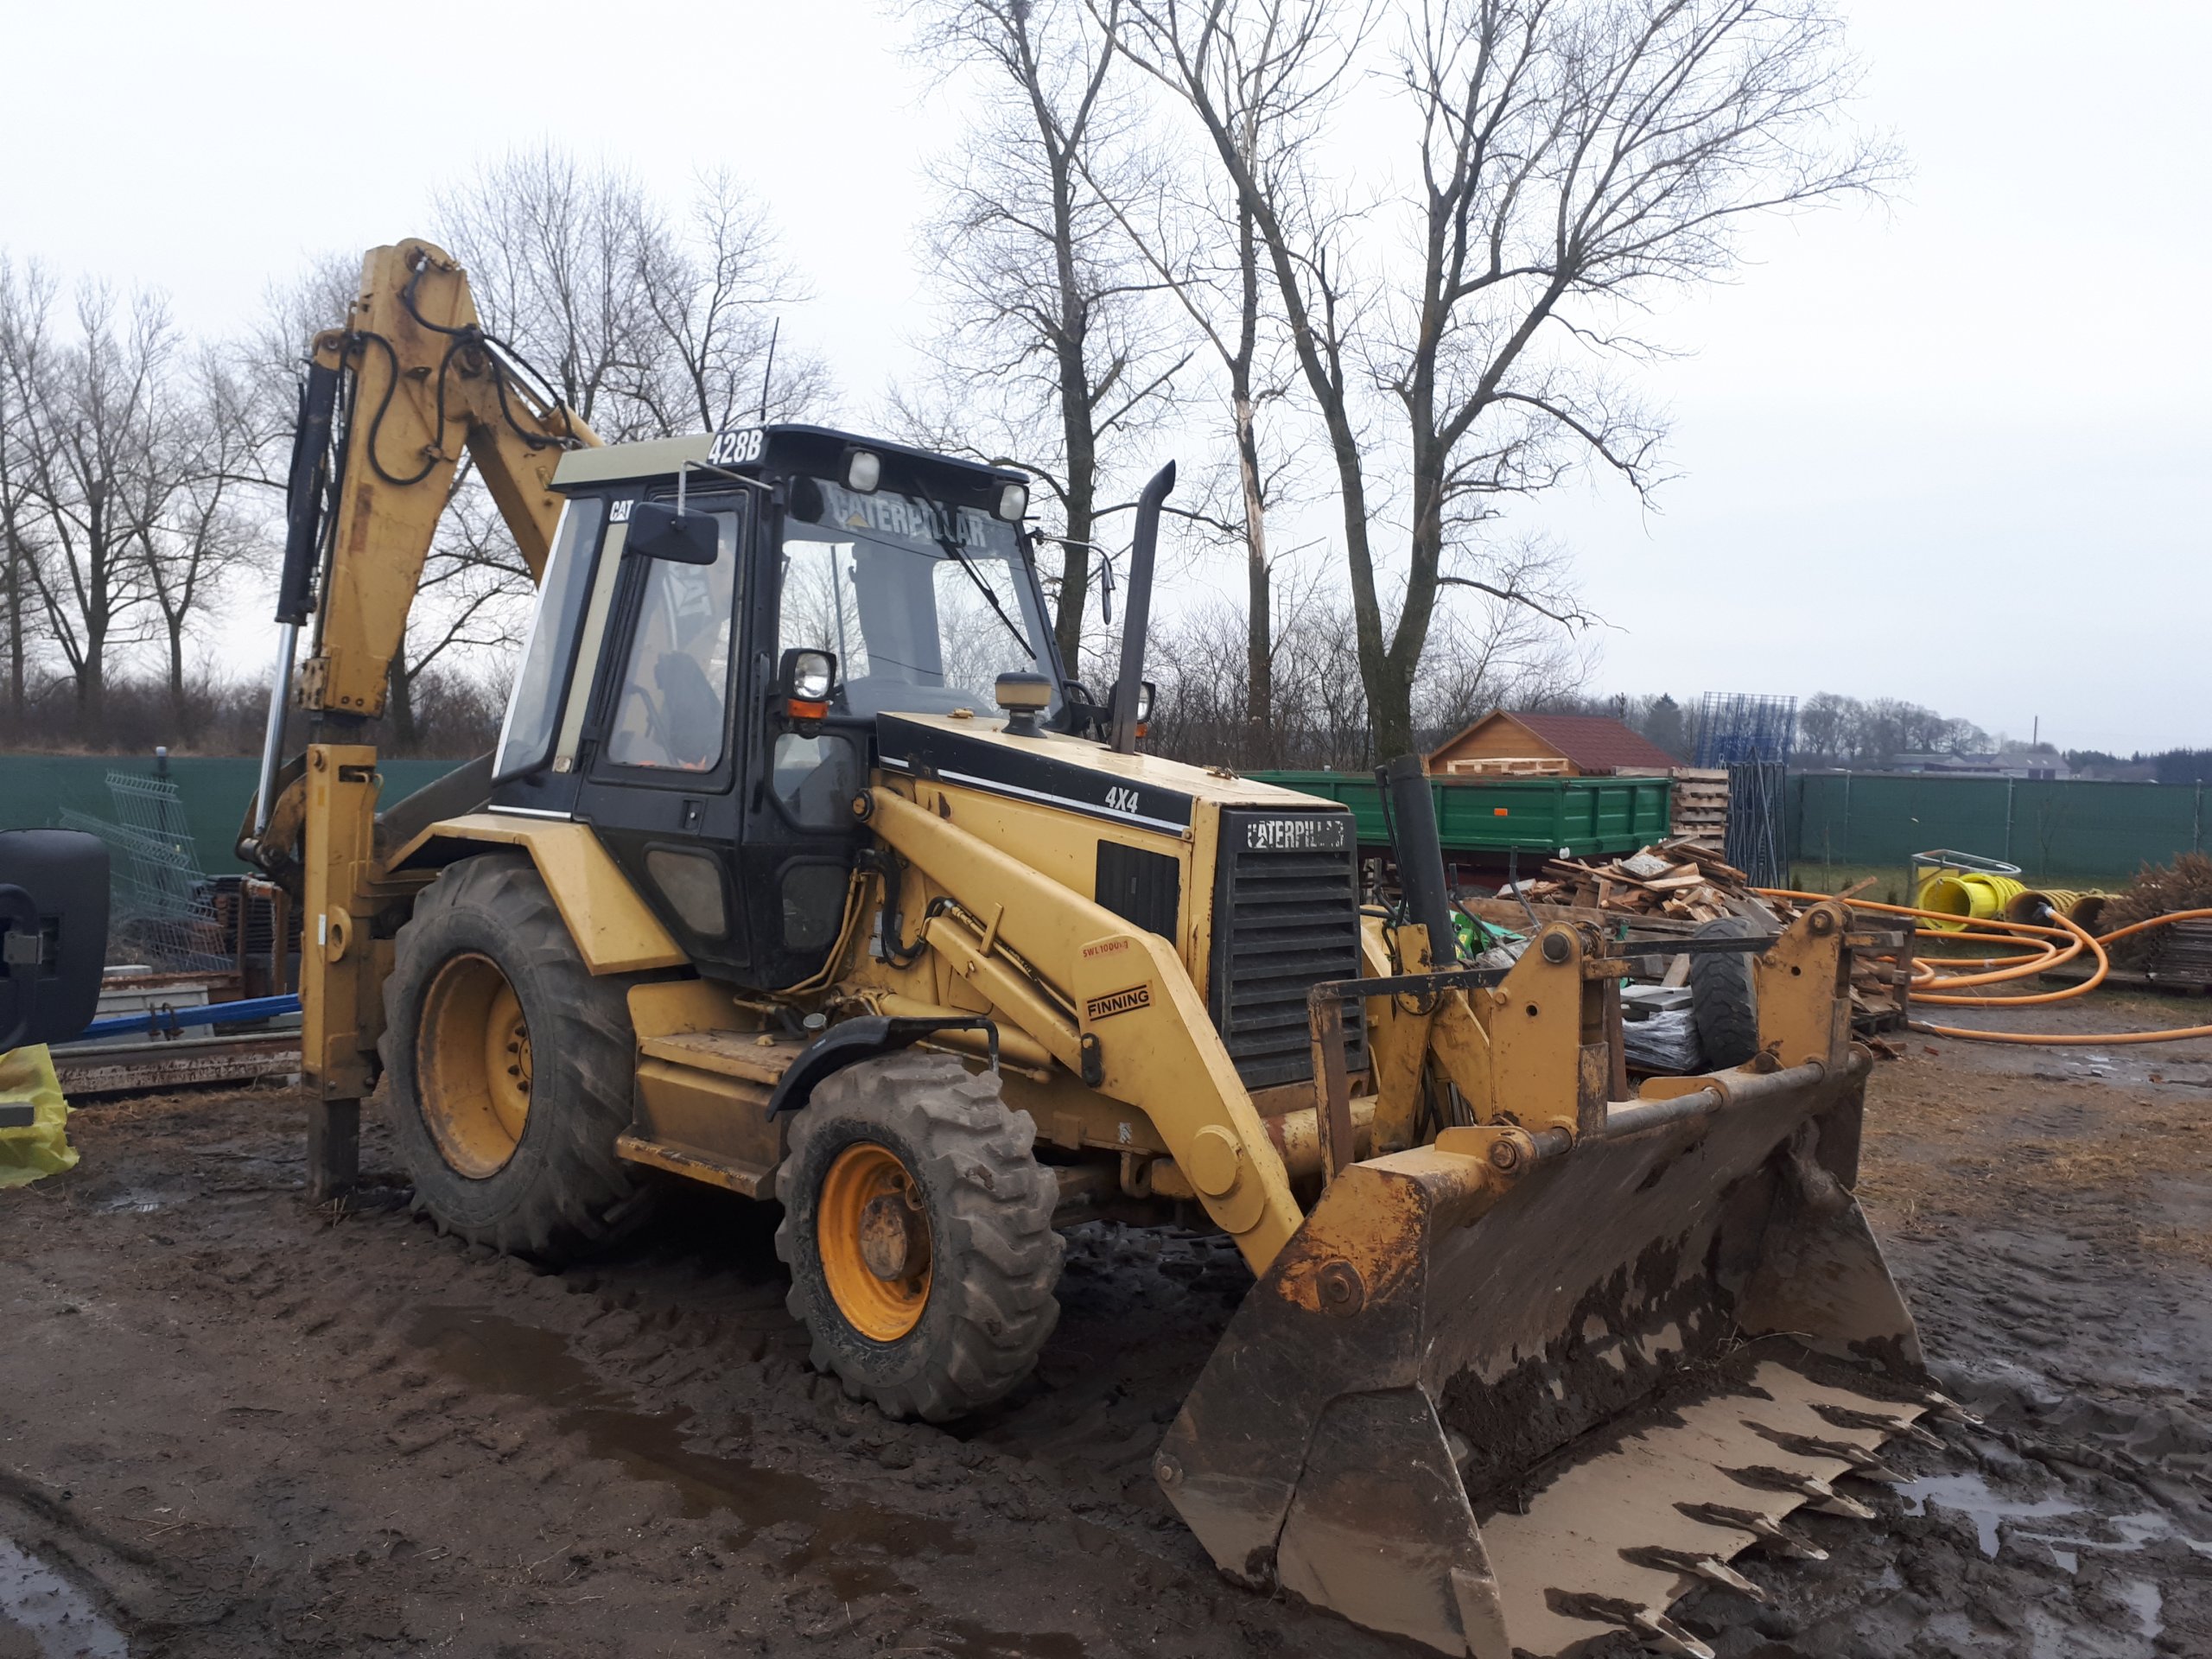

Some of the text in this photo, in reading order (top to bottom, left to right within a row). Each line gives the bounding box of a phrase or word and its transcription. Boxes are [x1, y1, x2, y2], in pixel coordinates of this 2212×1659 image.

[708, 429, 764, 465] 428B
[609, 499, 634, 522] CAT
[1105, 786, 1139, 814] 4X4
[1247, 820, 1344, 849] CATERPIL
[1083, 946, 1099, 958] SWL
[1088, 990, 1149, 1017] FINNING
